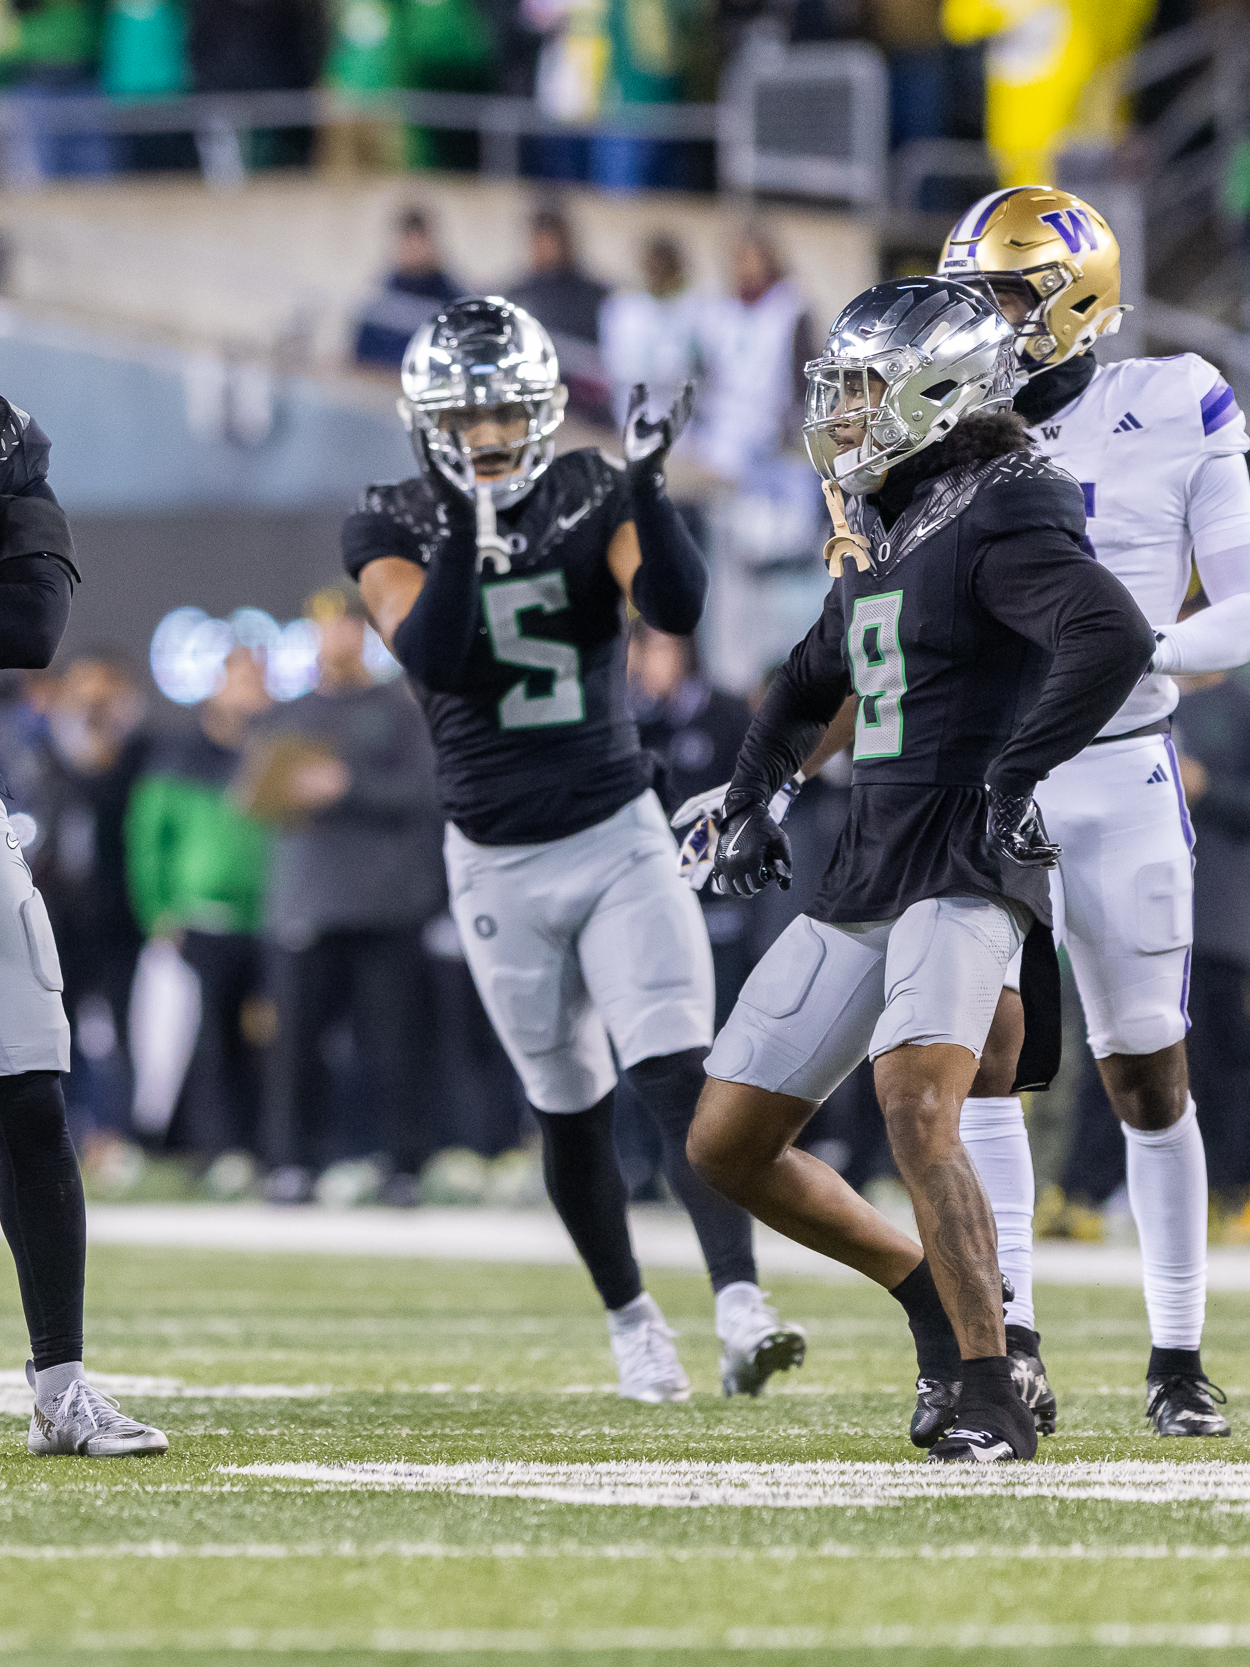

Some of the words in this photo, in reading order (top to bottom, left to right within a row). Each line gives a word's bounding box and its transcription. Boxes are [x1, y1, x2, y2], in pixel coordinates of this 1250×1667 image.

[1036, 206, 1099, 255] W
[1040, 425, 1062, 441] W
[481, 567, 587, 731] 5
